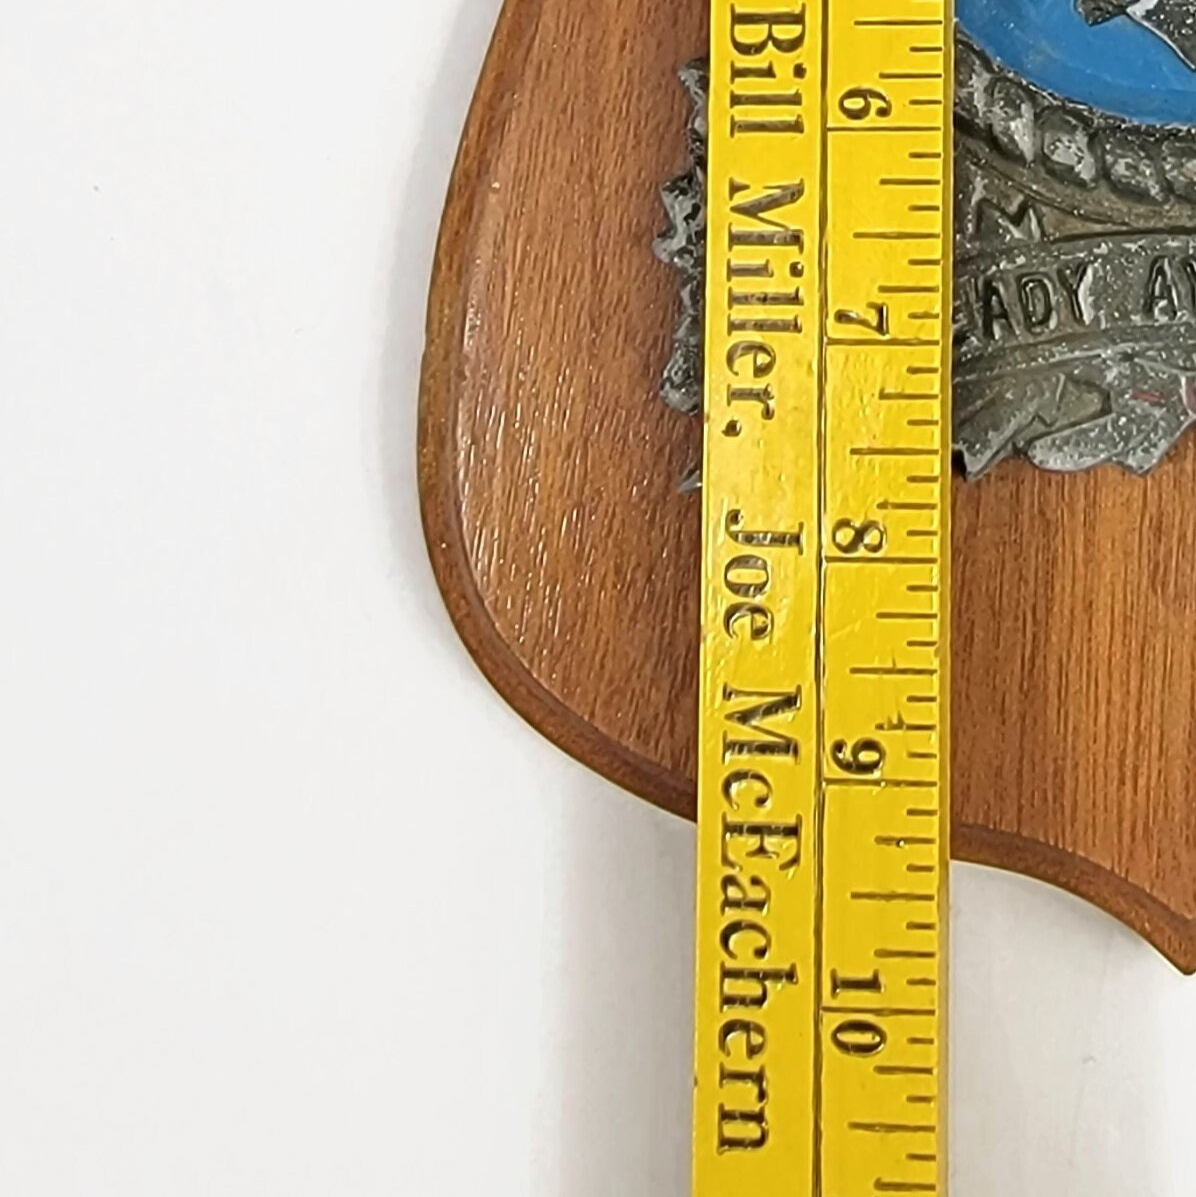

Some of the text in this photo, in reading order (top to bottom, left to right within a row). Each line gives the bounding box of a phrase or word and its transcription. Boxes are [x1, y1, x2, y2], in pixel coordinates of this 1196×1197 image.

[729, 2, 806, 139] Bill
[837, 86, 892, 120] 6
[834, 301, 889, 336] 7
[960, 260, 1096, 342] ADY
[723, 508, 804, 641] Joe
[831, 517, 888, 554] 8
[830, 738, 887, 774] 9
[716, 682, 802, 1155] McEachern
[830, 968, 887, 1057] 10
